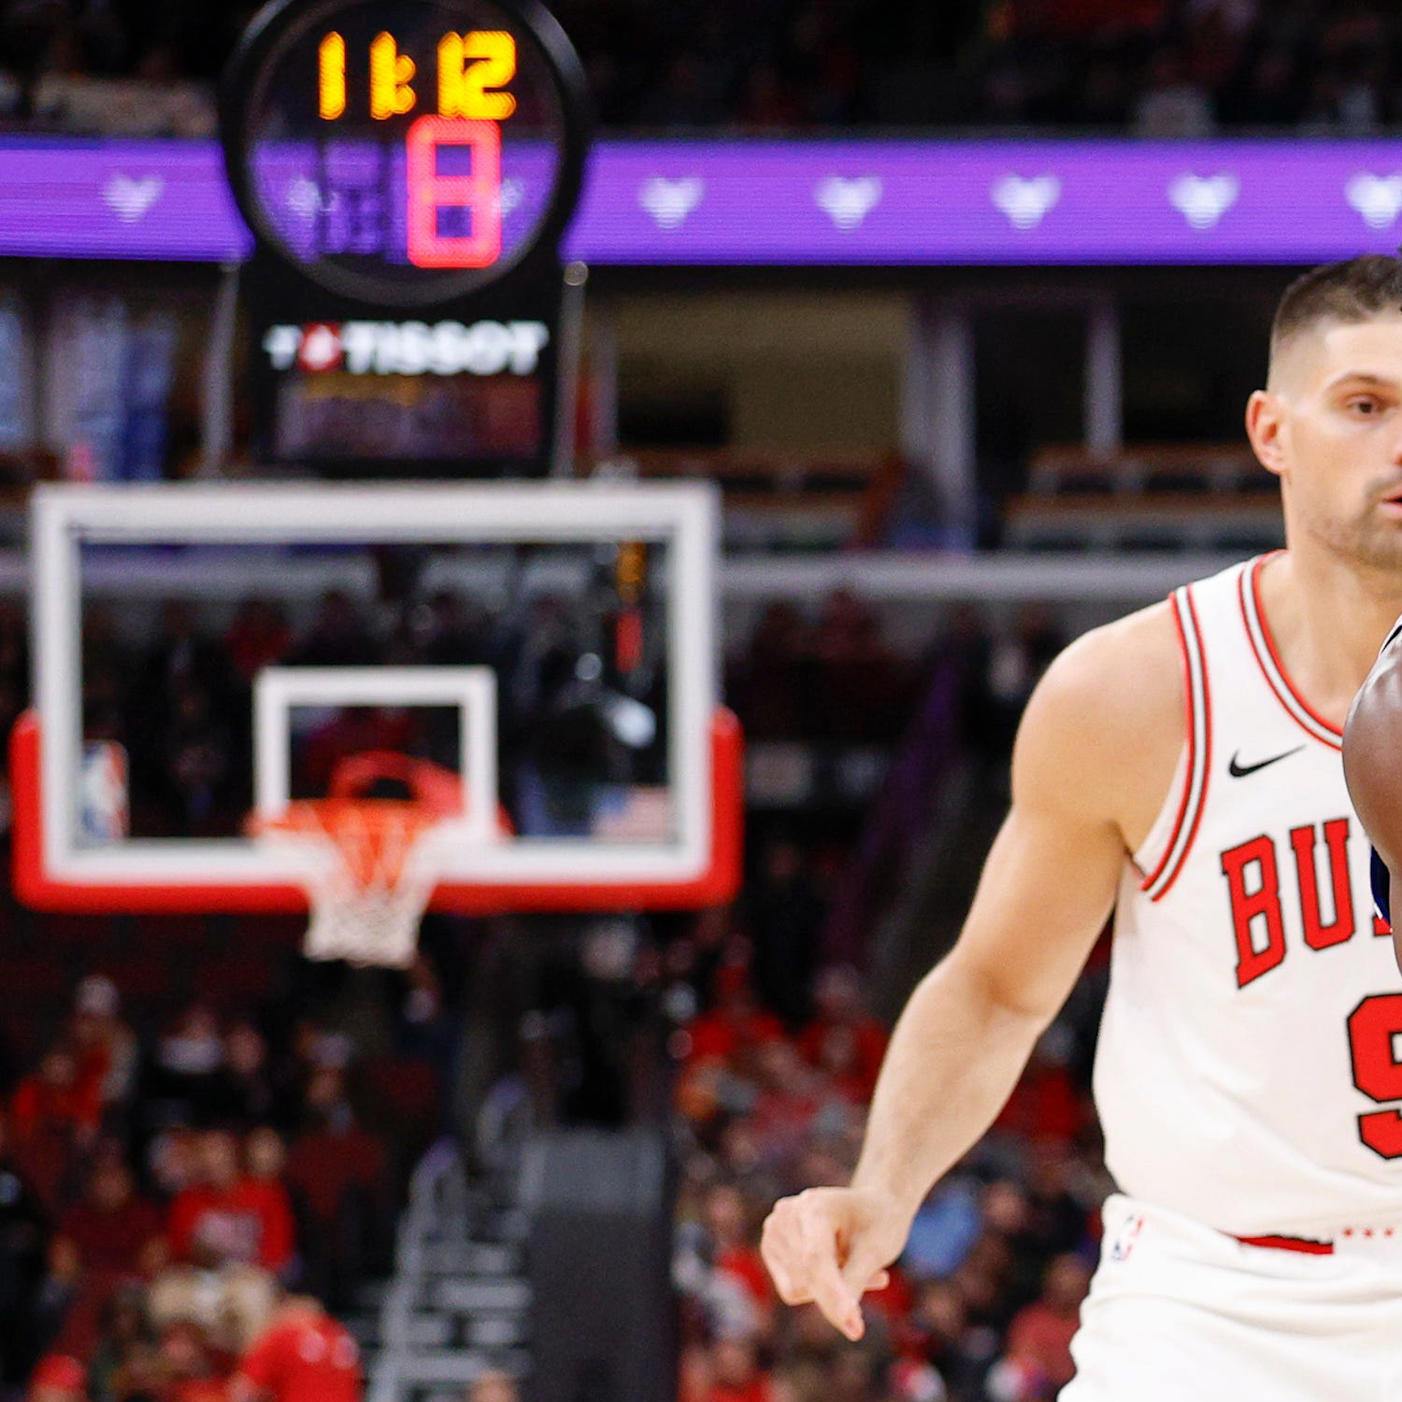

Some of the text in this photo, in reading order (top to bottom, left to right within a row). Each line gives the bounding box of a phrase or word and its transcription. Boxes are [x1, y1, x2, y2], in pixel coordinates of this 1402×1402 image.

[318, 31, 516, 120] 11:12
[405, 113, 502, 269] 8
[342, 319, 550, 376] TISSOT
[1220, 817, 1393, 989] BU
